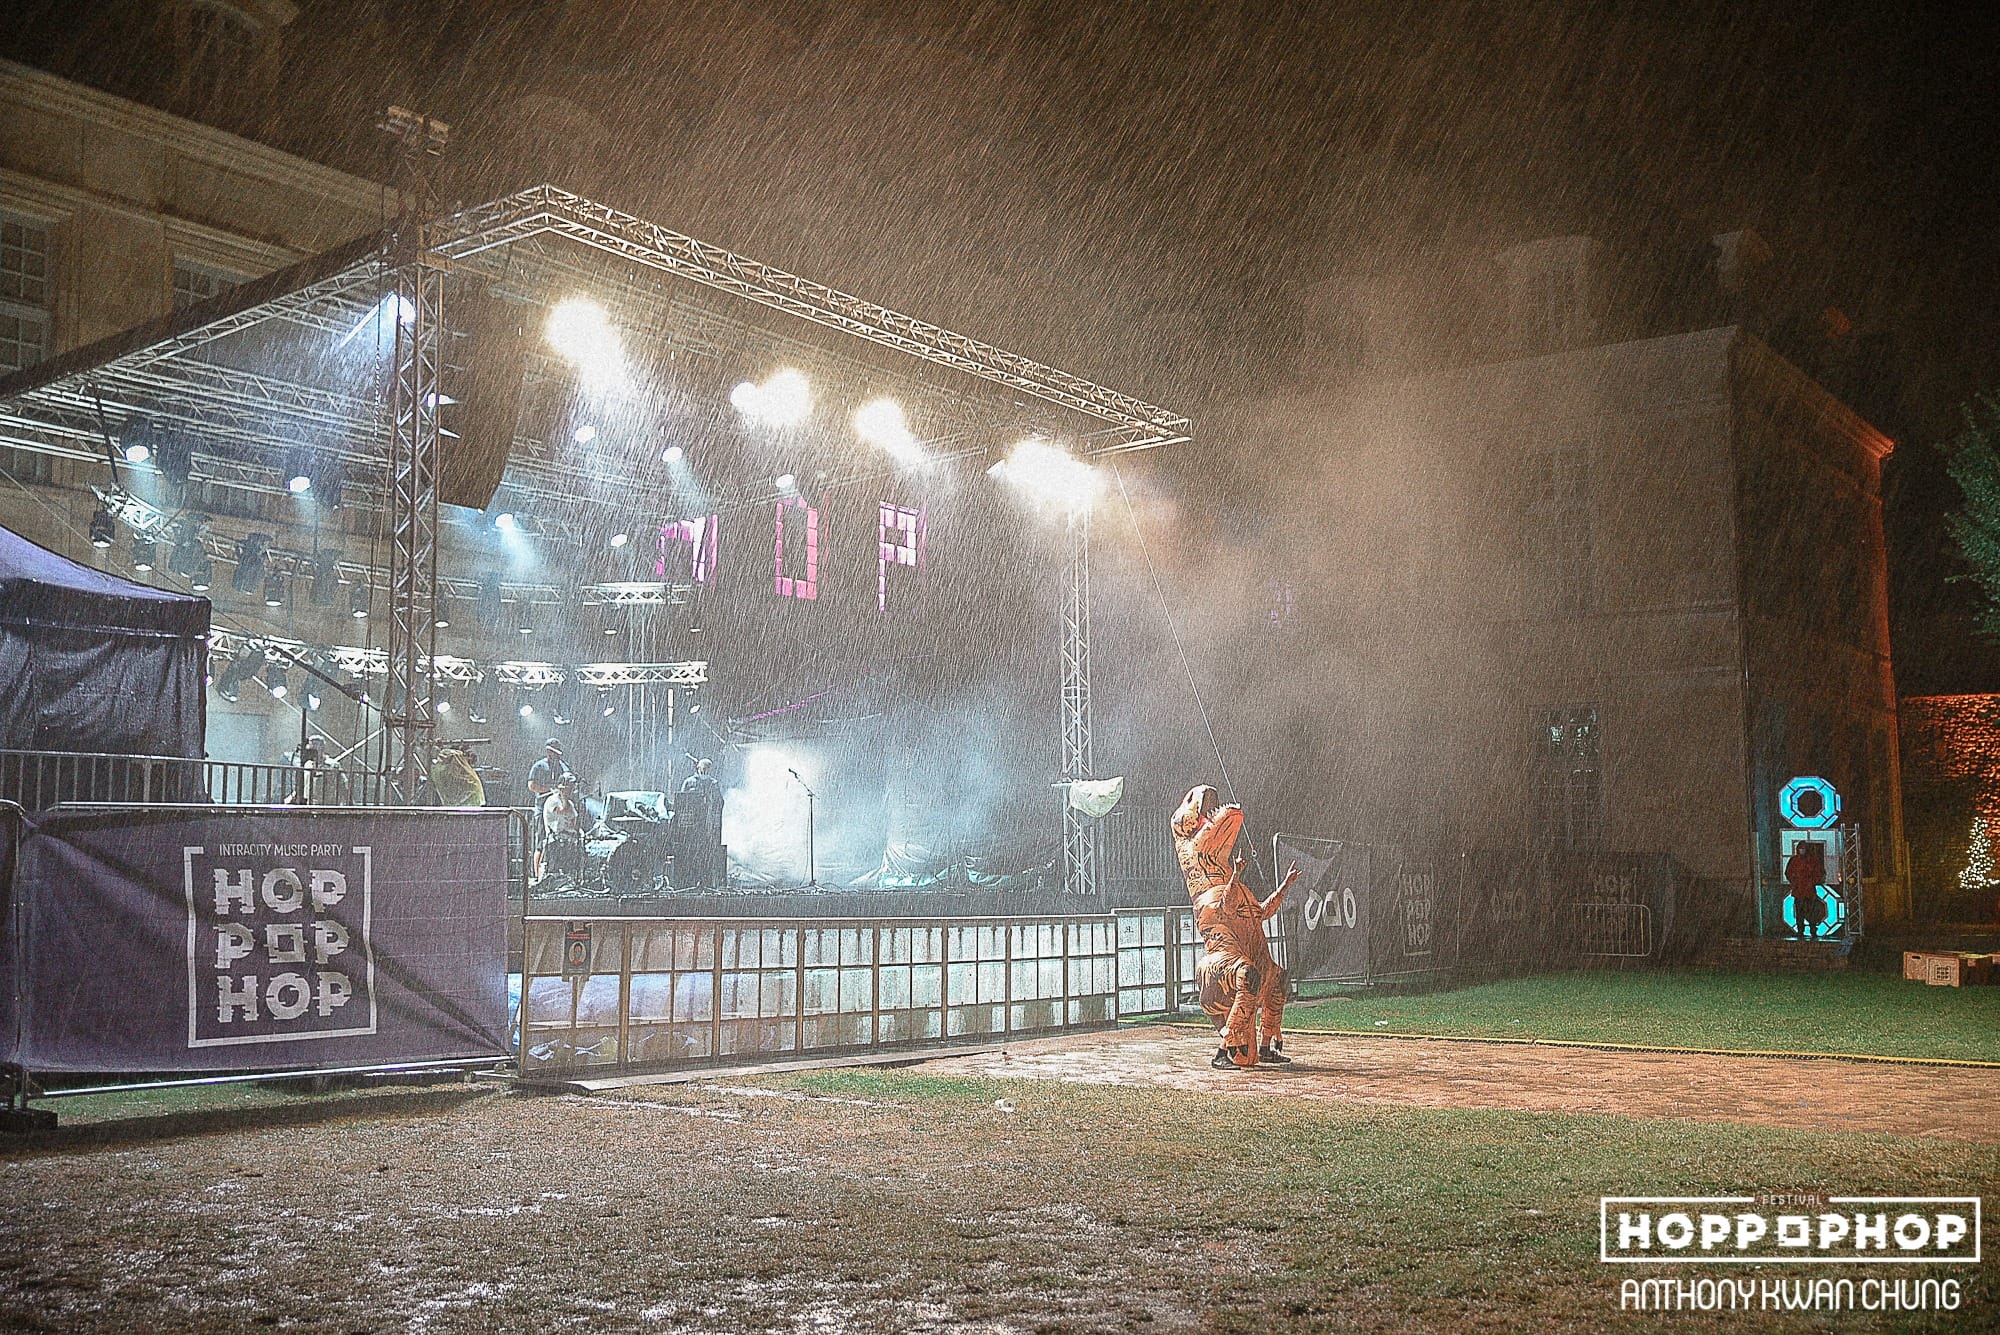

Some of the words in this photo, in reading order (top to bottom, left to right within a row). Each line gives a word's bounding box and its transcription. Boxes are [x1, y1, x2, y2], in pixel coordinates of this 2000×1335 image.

[219, 843, 271, 857] INTRACITY
[273, 843, 308, 857] MUSIC
[310, 843, 343, 857] PARTY
[213, 868, 347, 915] HOP
[213, 920, 350, 969] POP
[216, 972, 352, 1023] HOP
